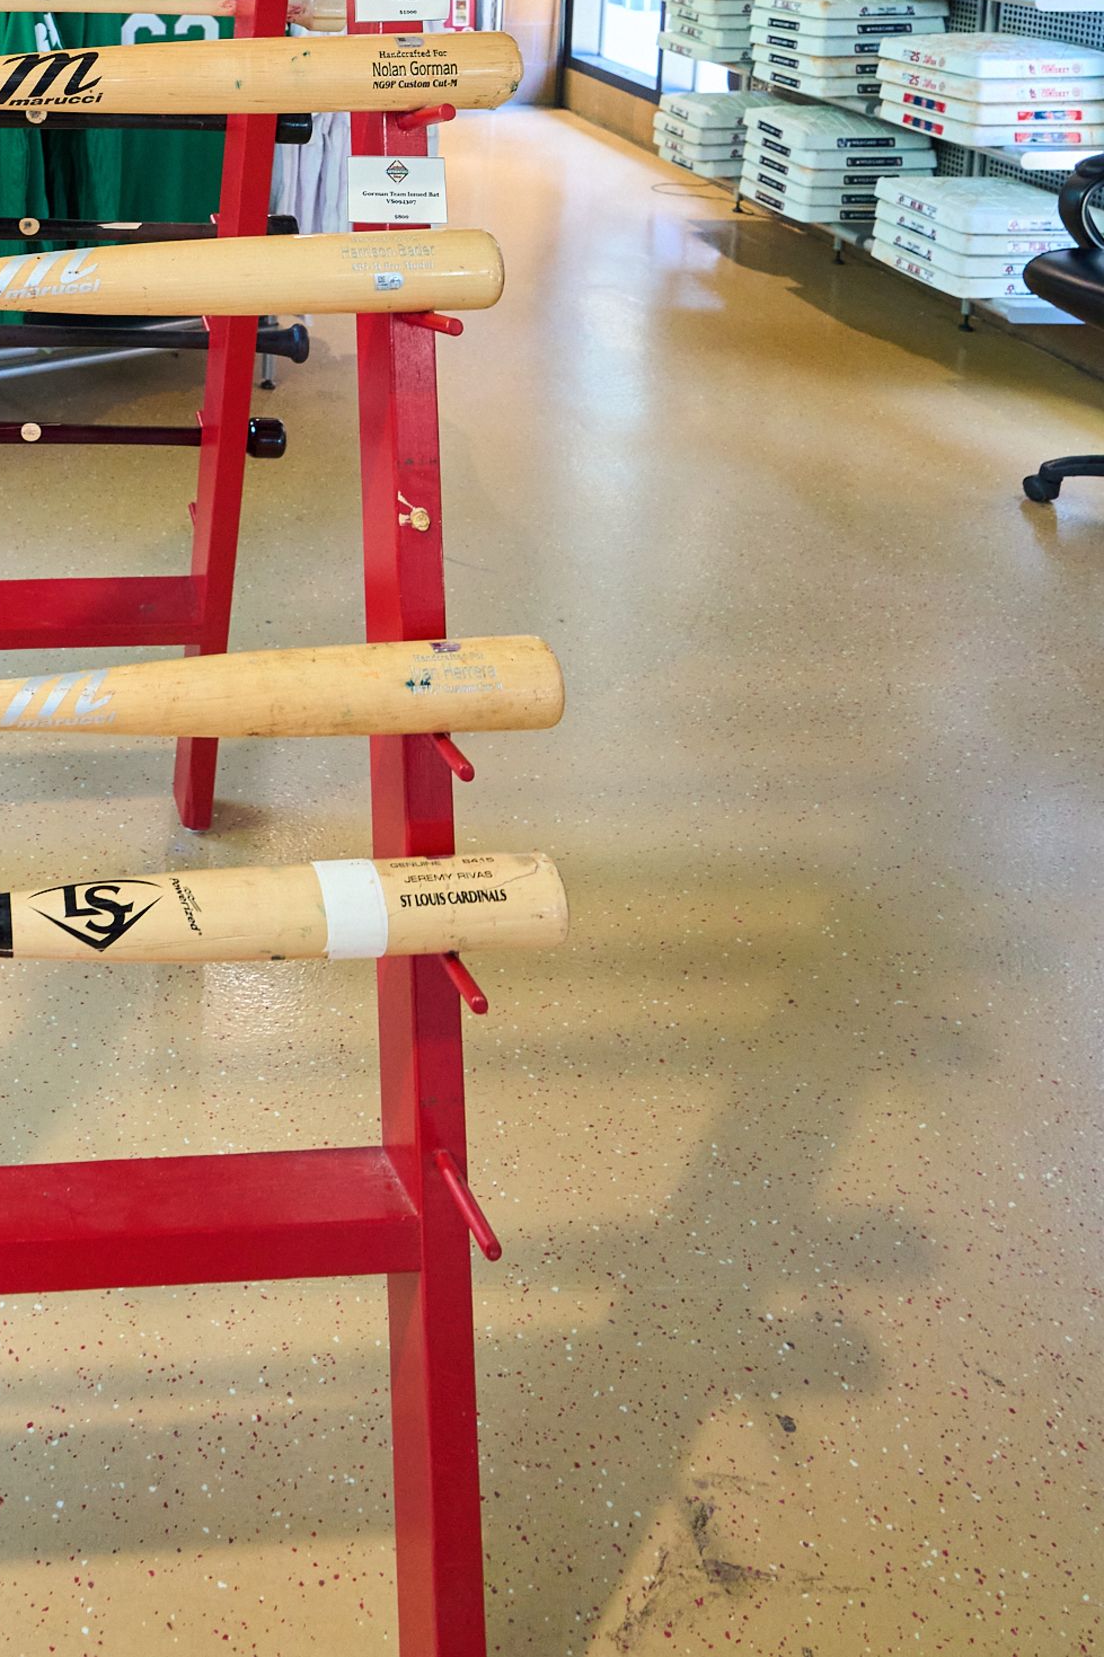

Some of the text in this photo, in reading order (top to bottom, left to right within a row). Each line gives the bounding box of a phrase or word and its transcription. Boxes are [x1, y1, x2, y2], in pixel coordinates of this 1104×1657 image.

[379, 50, 431, 58] Handcrafted
[372, 61, 458, 77] Nolan Gorman
[398, 80, 431, 88] Custom
[432, 79, 458, 87] Cut-M
[9, 92, 103, 106] marucci
[4, 279, 102, 300] marucci
[17, 711, 116, 728] marucci
[404, 871, 493, 883] JEREMY RIVAS
[400, 888, 508, 907] ST LOUIS CARDINALS
